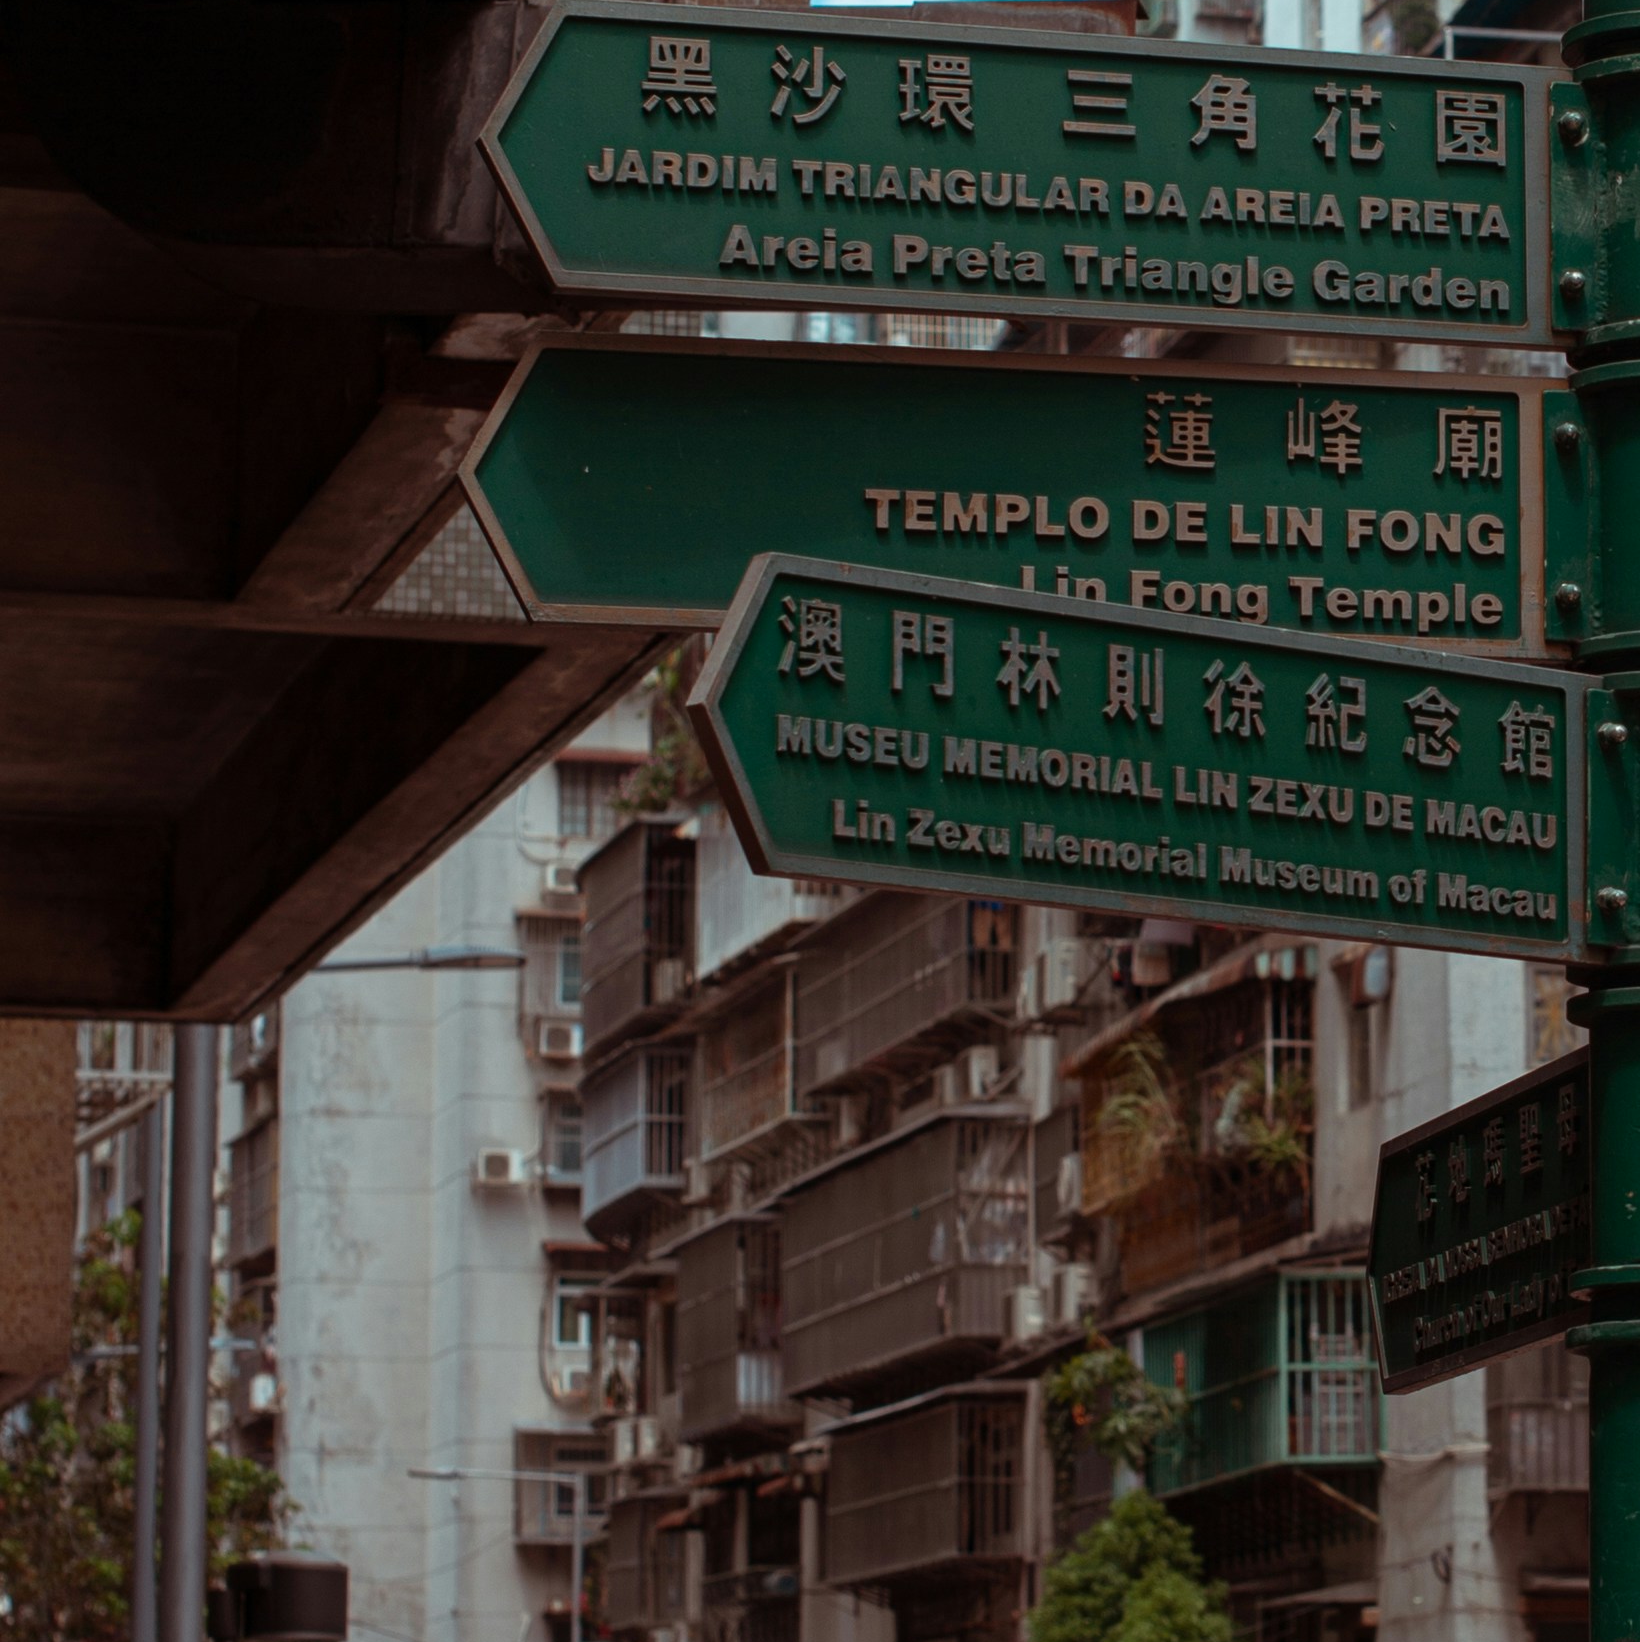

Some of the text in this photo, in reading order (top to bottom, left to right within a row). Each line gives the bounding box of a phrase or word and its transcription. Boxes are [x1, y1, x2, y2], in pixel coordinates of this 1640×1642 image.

[641, 35, 1509, 167] 黑沙環三角花園
[587, 147, 1511, 240] JARDIM TRIANGULAR DA AREIA PRETA
[719, 223, 1510, 311] Areia Preta Triangle Garden
[1145, 392, 1503, 481] 蓮峰廟
[864, 488, 1505, 556] TEMPLO DE LIN FONG
[1129, 570, 1270, 625] Fong
[1288, 577, 1504, 636] Temple
[777, 593, 1556, 780] 澳門林則徐紀念館
[775, 715, 1557, 850] MUSEU MEMORIAL LIN ZEXU DE MACAU
[832, 798, 1557, 921] Lin Zexu Memorial Museum of Macau
